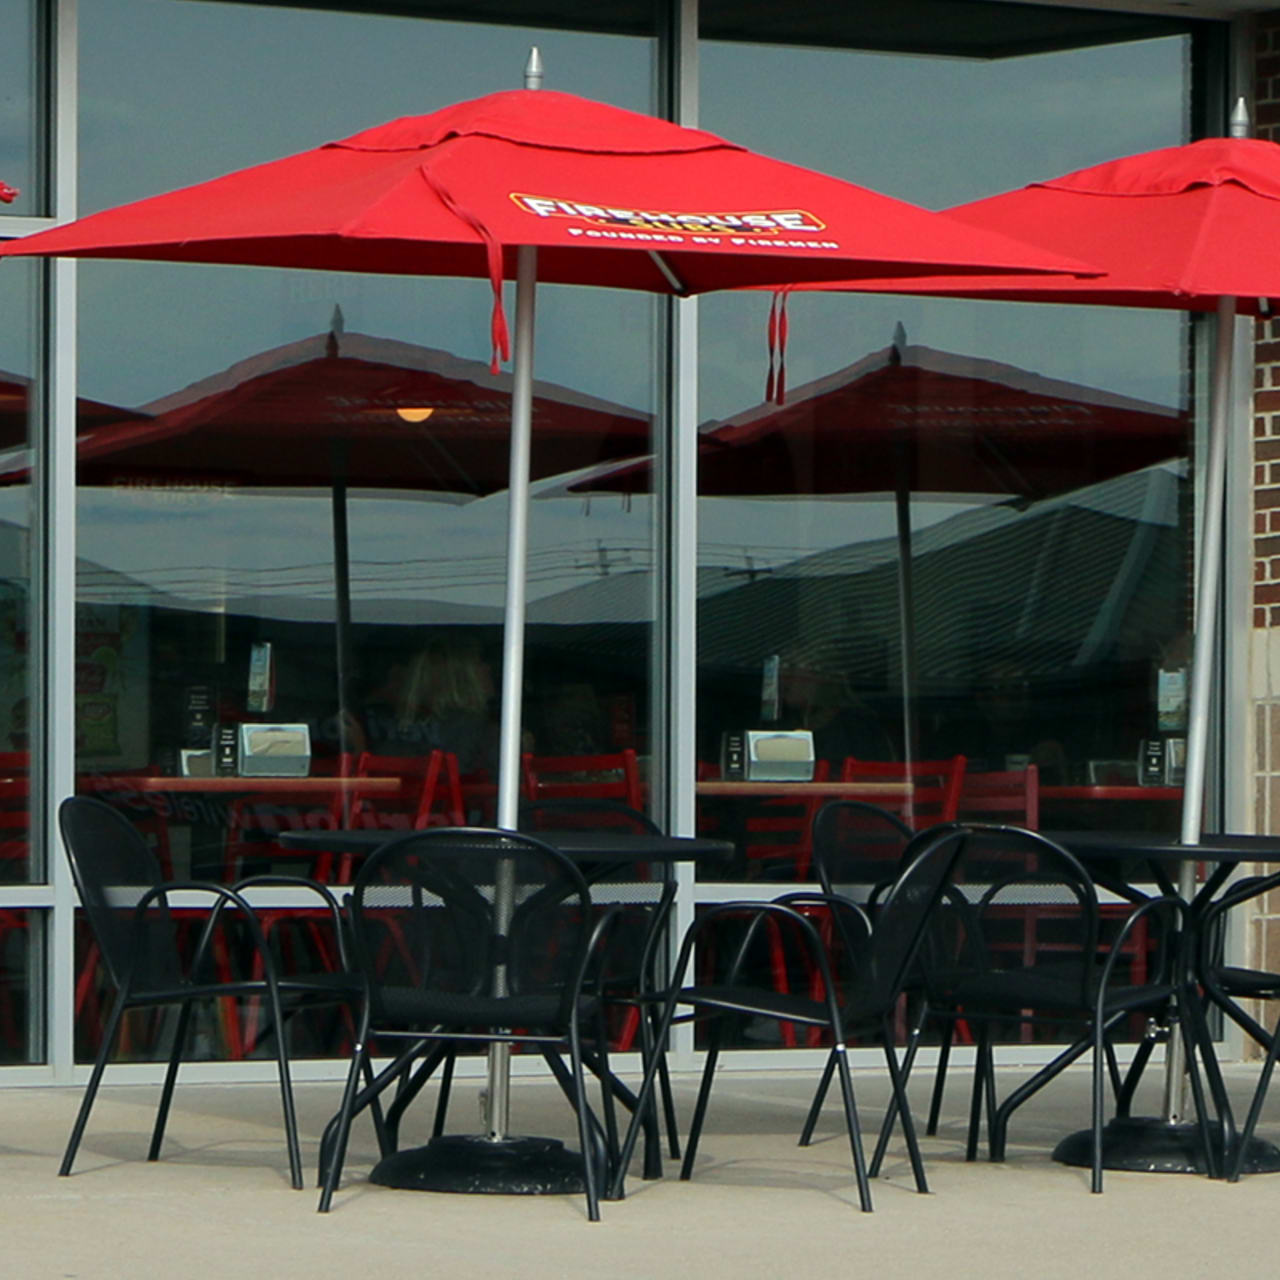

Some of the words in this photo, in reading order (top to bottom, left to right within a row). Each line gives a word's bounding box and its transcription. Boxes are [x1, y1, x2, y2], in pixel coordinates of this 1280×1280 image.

[522, 196, 821, 232] FIREHOUSE
[568, 227, 685, 242] FOUNDED
[691, 235, 721, 244] BY
